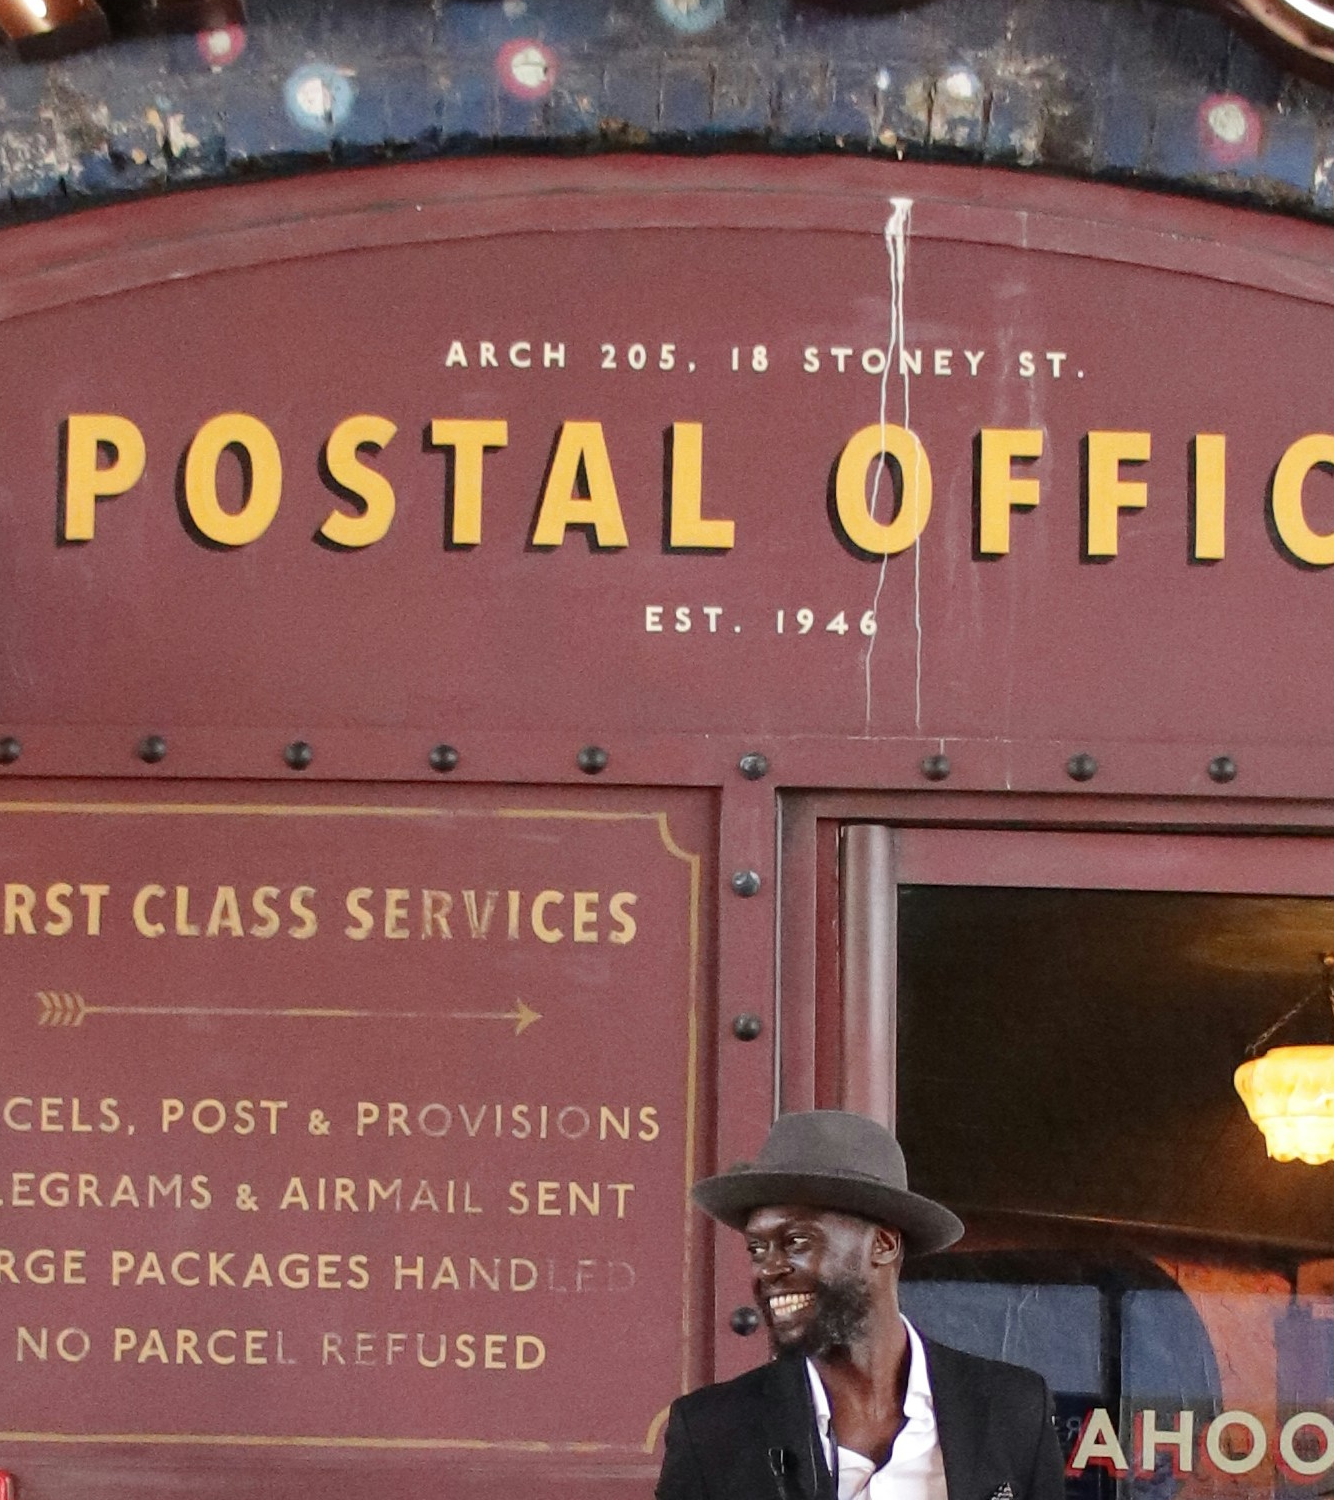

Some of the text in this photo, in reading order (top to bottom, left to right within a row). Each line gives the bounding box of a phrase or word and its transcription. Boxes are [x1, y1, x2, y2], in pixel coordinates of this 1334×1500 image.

[445, 340, 1086, 379] ARCH 205, 18 STONEY ST.
[65, 414, 736, 550] POSTAL
[646, 606, 877, 635] EST. 1946
[133, 884, 317, 940] CLASS
[345, 886, 638, 946] SERVICES
[161, 1099, 288, 1137] POST
[309, 1109, 331, 1136] &
[357, 1103, 660, 1142] PROVISIONS
[236, 1184, 259, 1210] &
[280, 1177, 483, 1215] AIRMAIL
[508, 1182, 634, 1218] SENT
[112, 1251, 371, 1289] PACKAGES
[395, 1256, 637, 1293] HANDLED
[17, 1328, 547, 1371] NO PARCEL REFUSED
